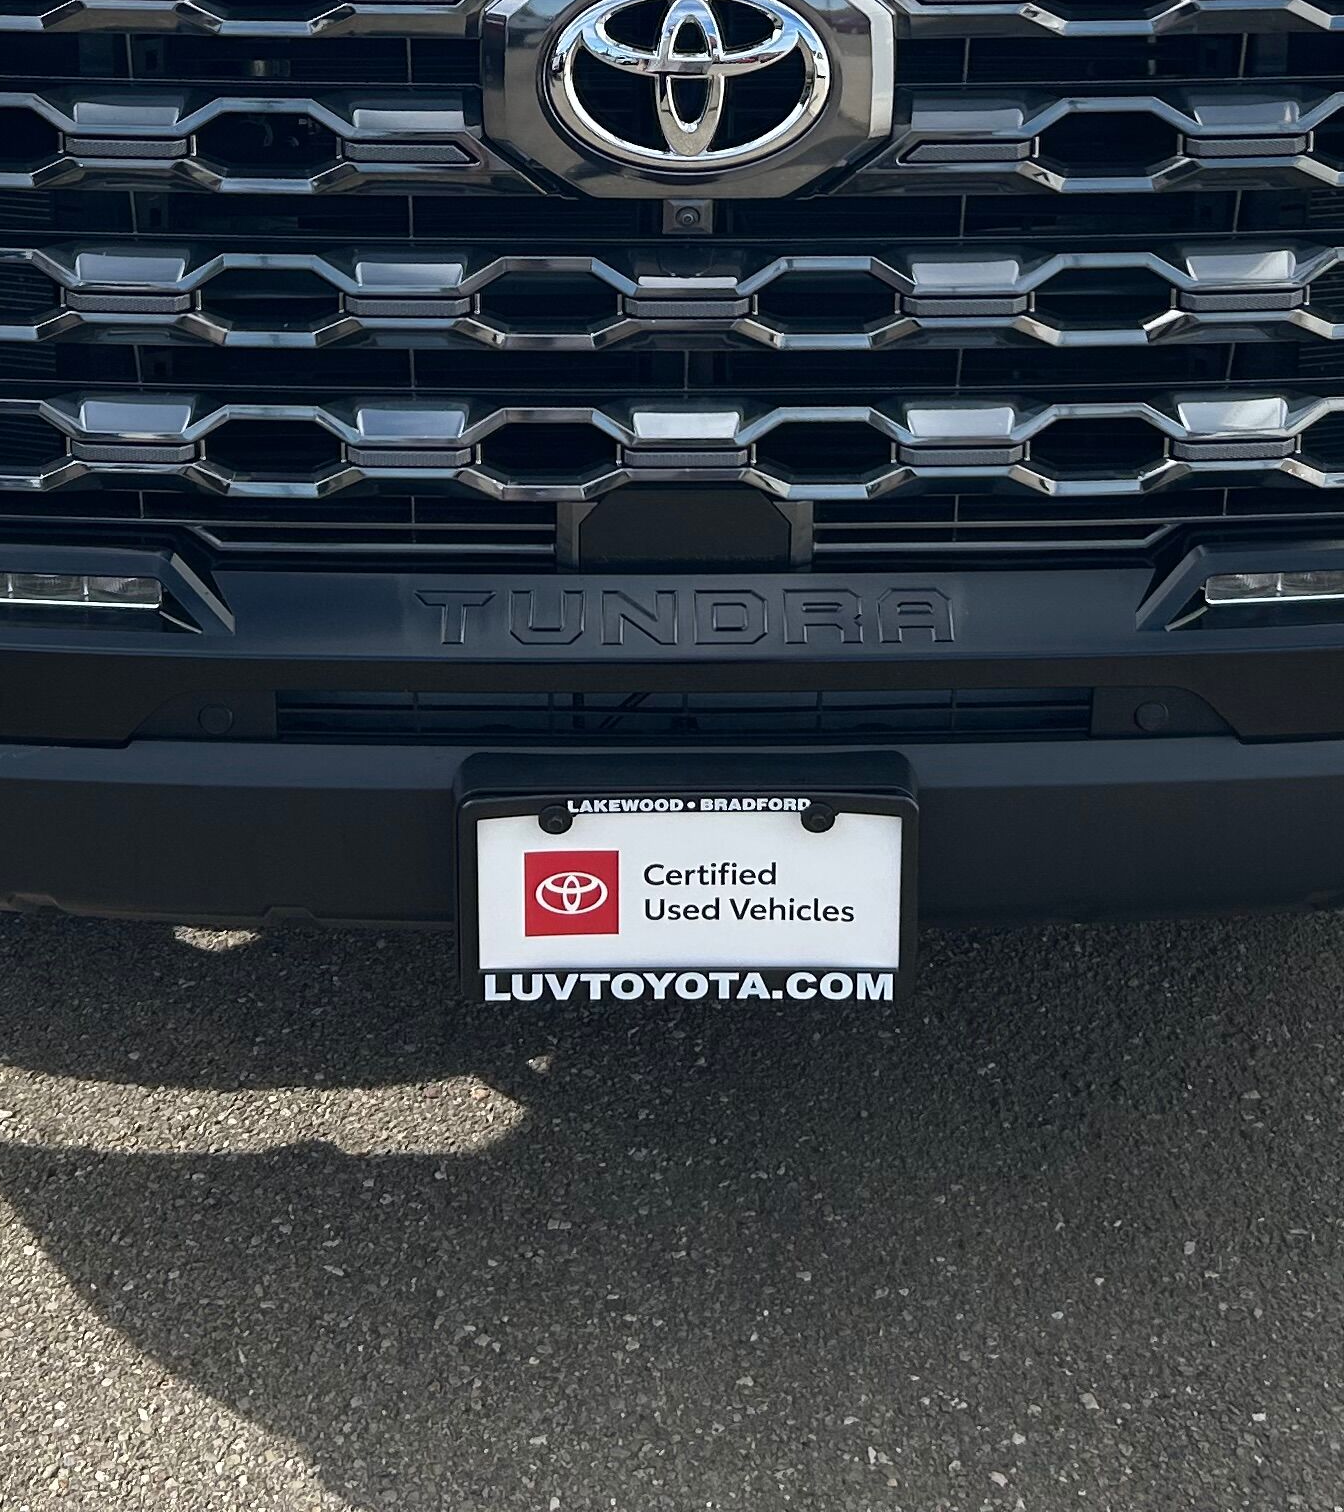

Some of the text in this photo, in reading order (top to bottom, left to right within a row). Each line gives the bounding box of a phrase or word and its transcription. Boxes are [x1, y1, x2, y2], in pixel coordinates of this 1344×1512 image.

[414, 588, 957, 646] TUNDRA
[567, 798, 811, 813] LAKEWOOD BRADFORD
[643, 862, 777, 886] Certified
[644, 897, 855, 923] Used Vehicles
[484, 972, 894, 1002] LUVTOYOTA.COM
